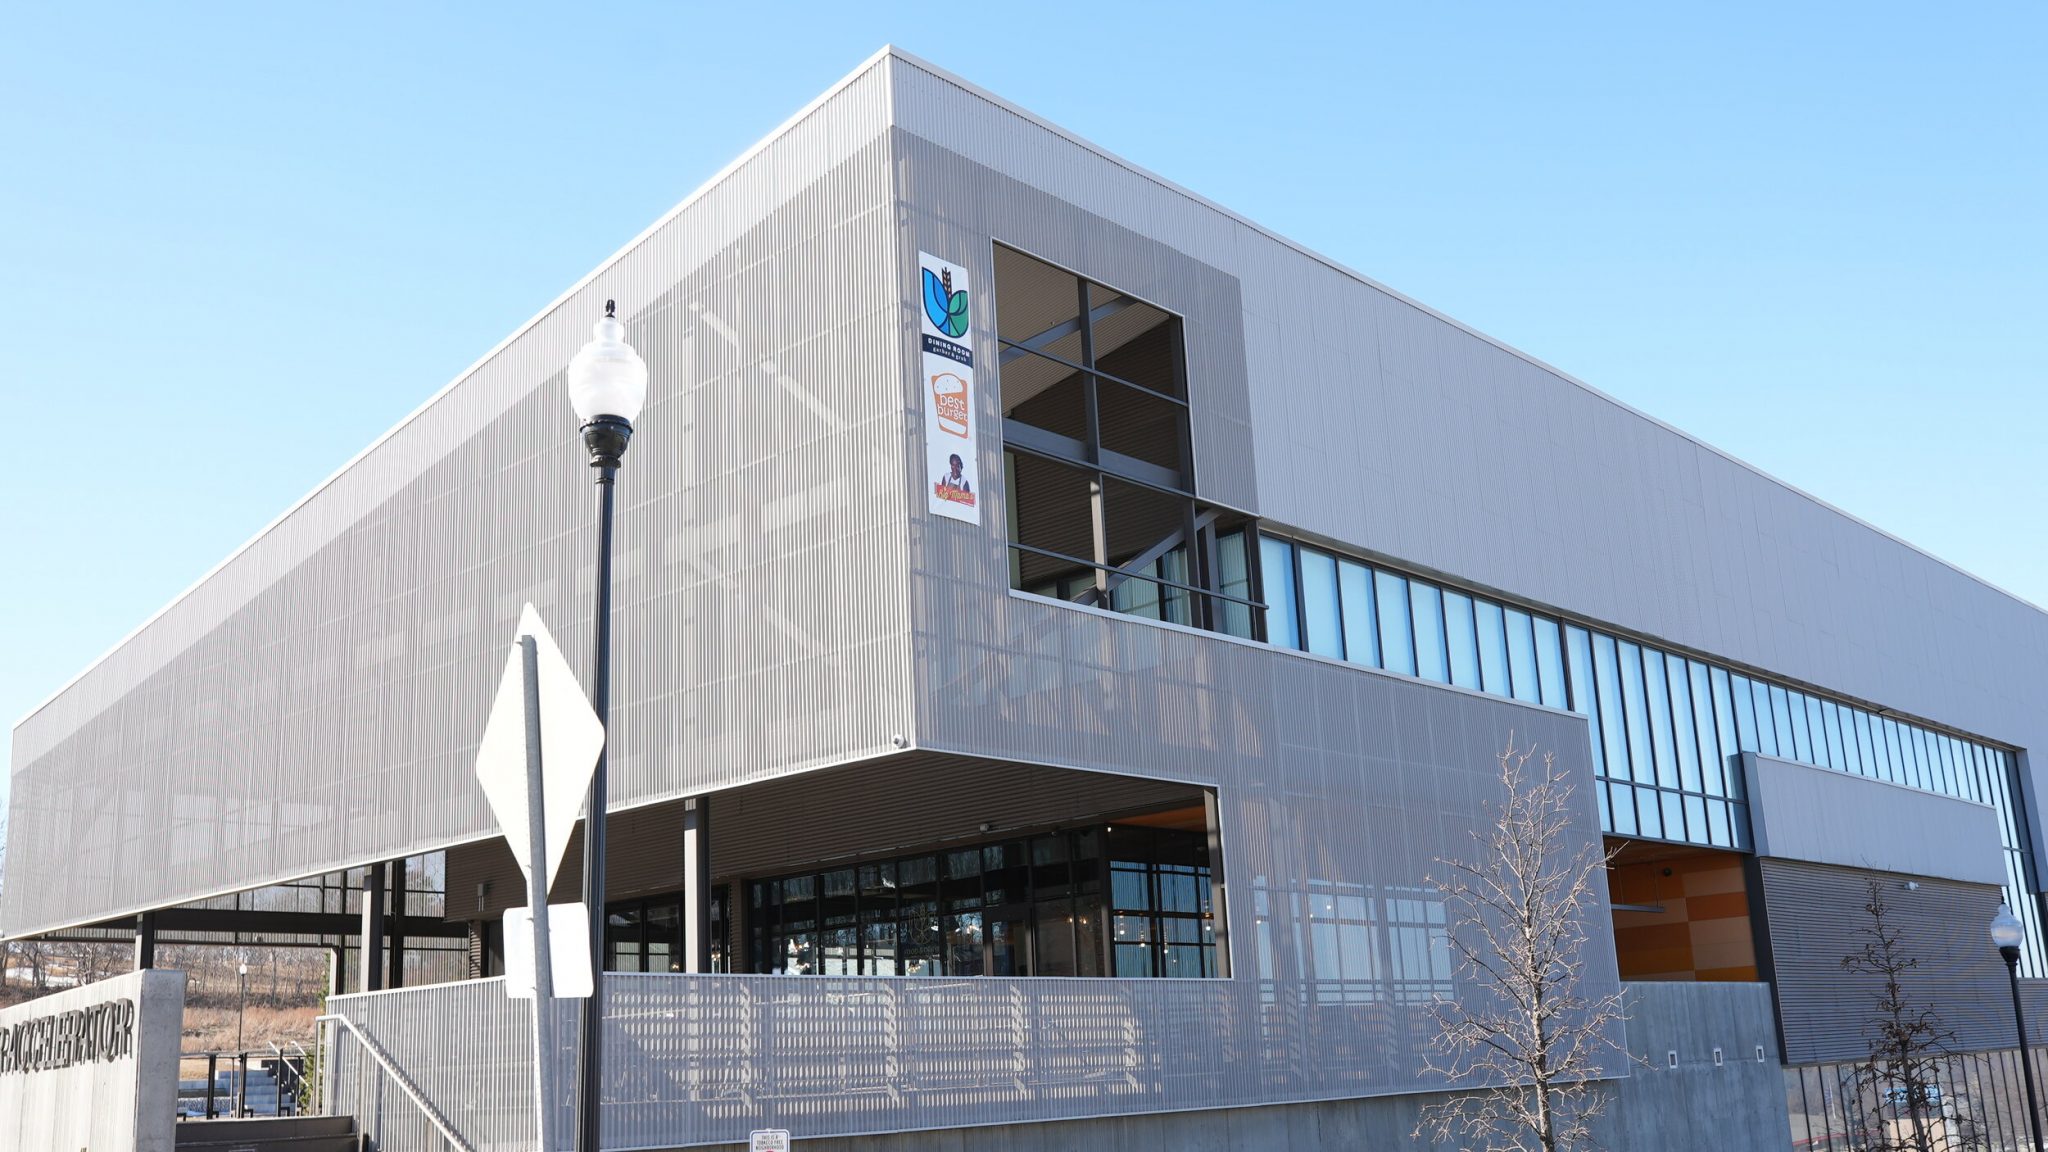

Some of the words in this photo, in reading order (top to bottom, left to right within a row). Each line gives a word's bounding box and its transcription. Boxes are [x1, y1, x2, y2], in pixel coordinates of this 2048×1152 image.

[927, 338, 951, 349] DINING
[952, 345, 970, 358] ROOM
[940, 394, 966, 410] best
[937, 404, 968, 422] burger
